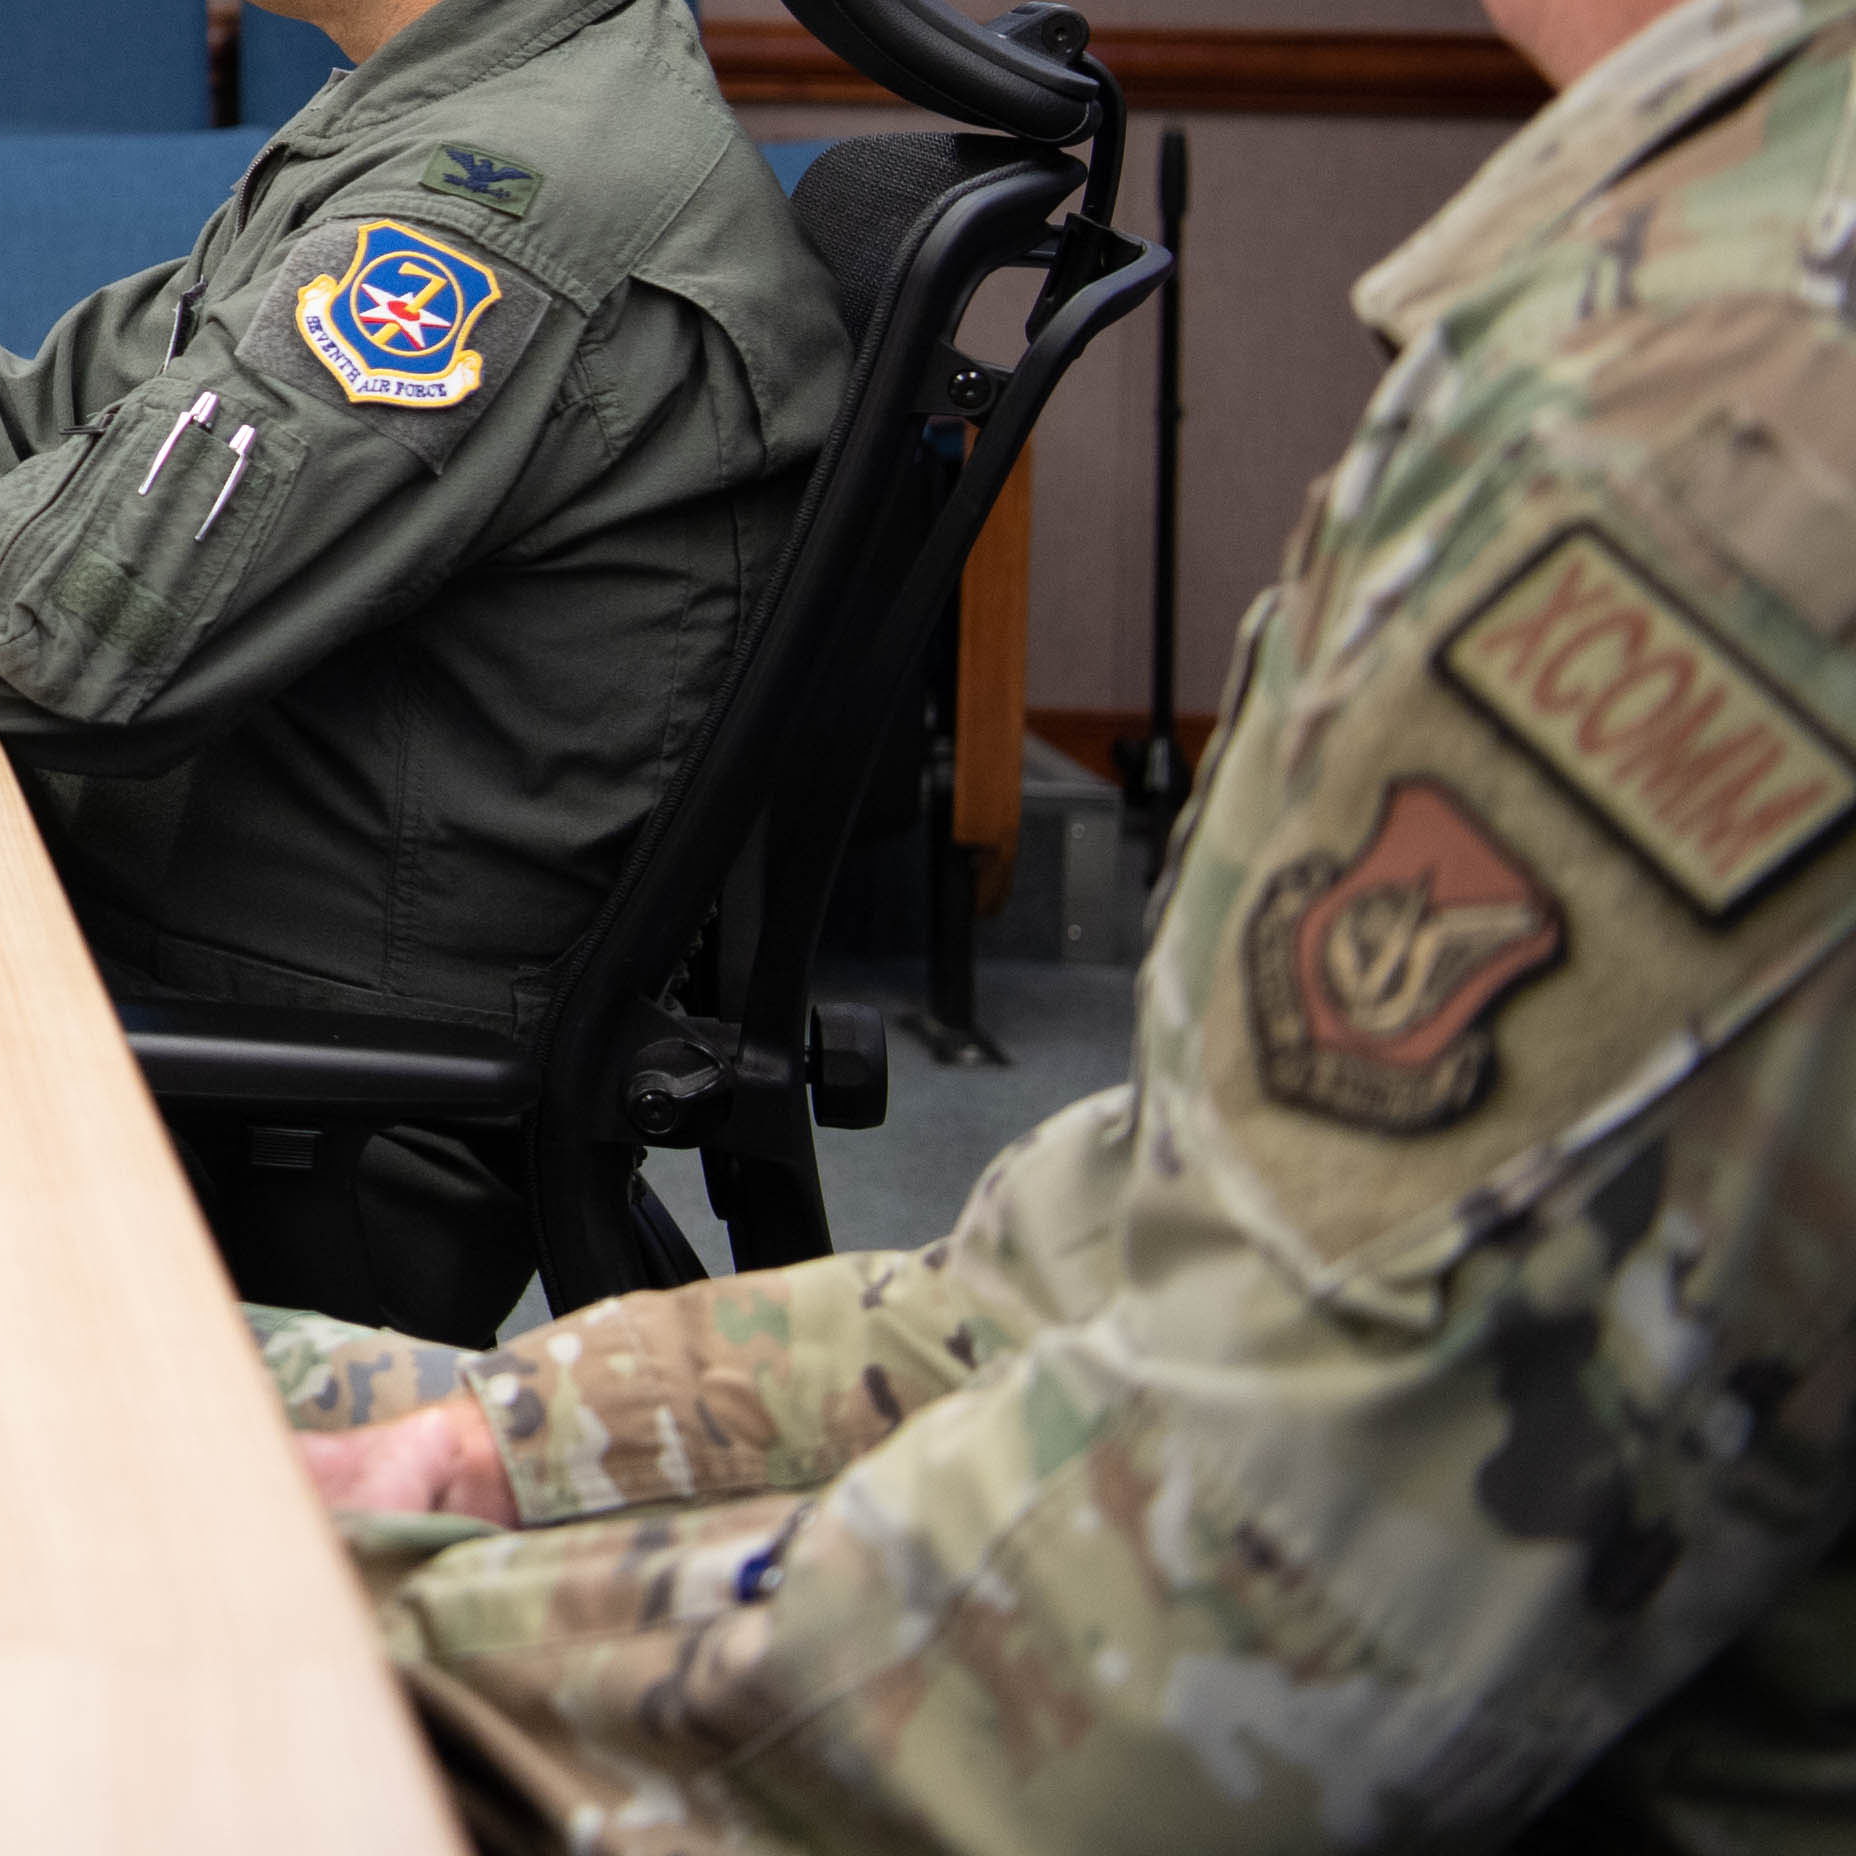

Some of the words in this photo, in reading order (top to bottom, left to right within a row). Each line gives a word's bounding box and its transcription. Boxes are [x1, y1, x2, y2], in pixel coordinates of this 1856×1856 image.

[371, 261, 447, 346] 7
[306, 315, 361, 383] SEVENTH
[357, 378, 390, 394] AIR
[395, 381, 447, 398] FORCE
